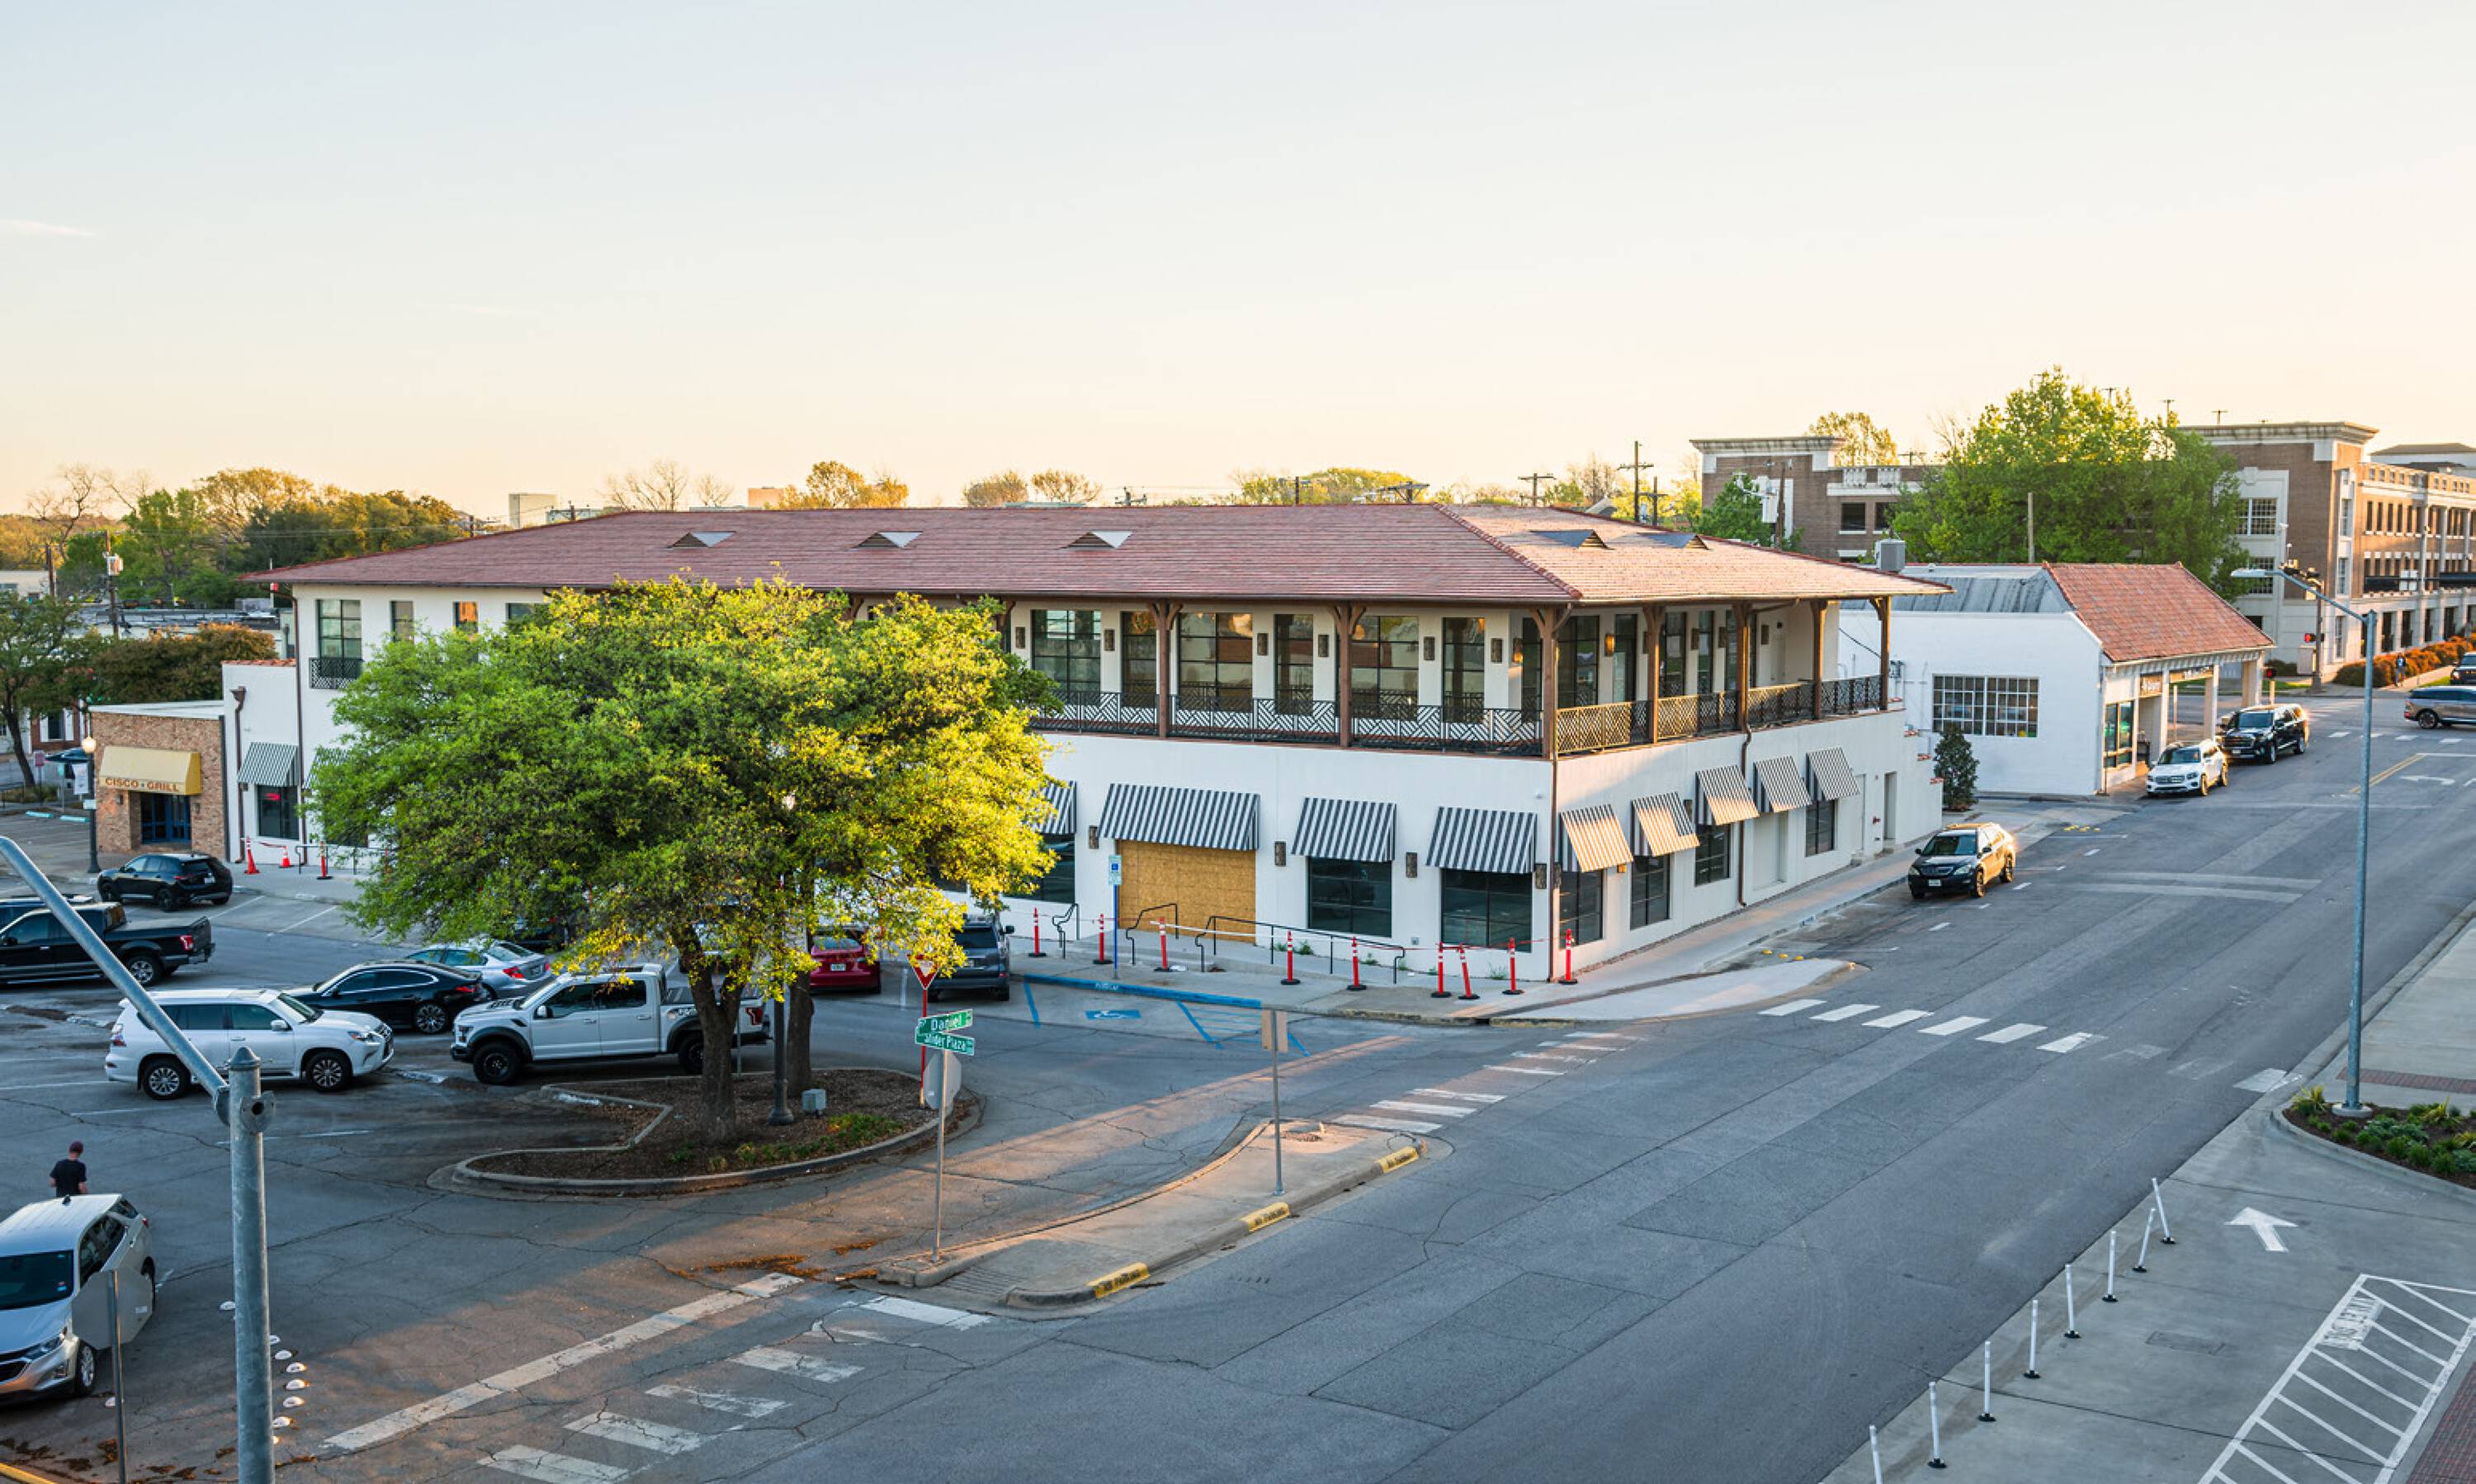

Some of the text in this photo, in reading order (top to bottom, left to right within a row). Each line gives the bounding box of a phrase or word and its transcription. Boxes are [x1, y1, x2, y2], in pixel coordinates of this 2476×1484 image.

[106, 777, 179, 792] CISCO GRILL
[930, 1014, 962, 1031] Daniel
[946, 1036, 966, 1051] Plaza
